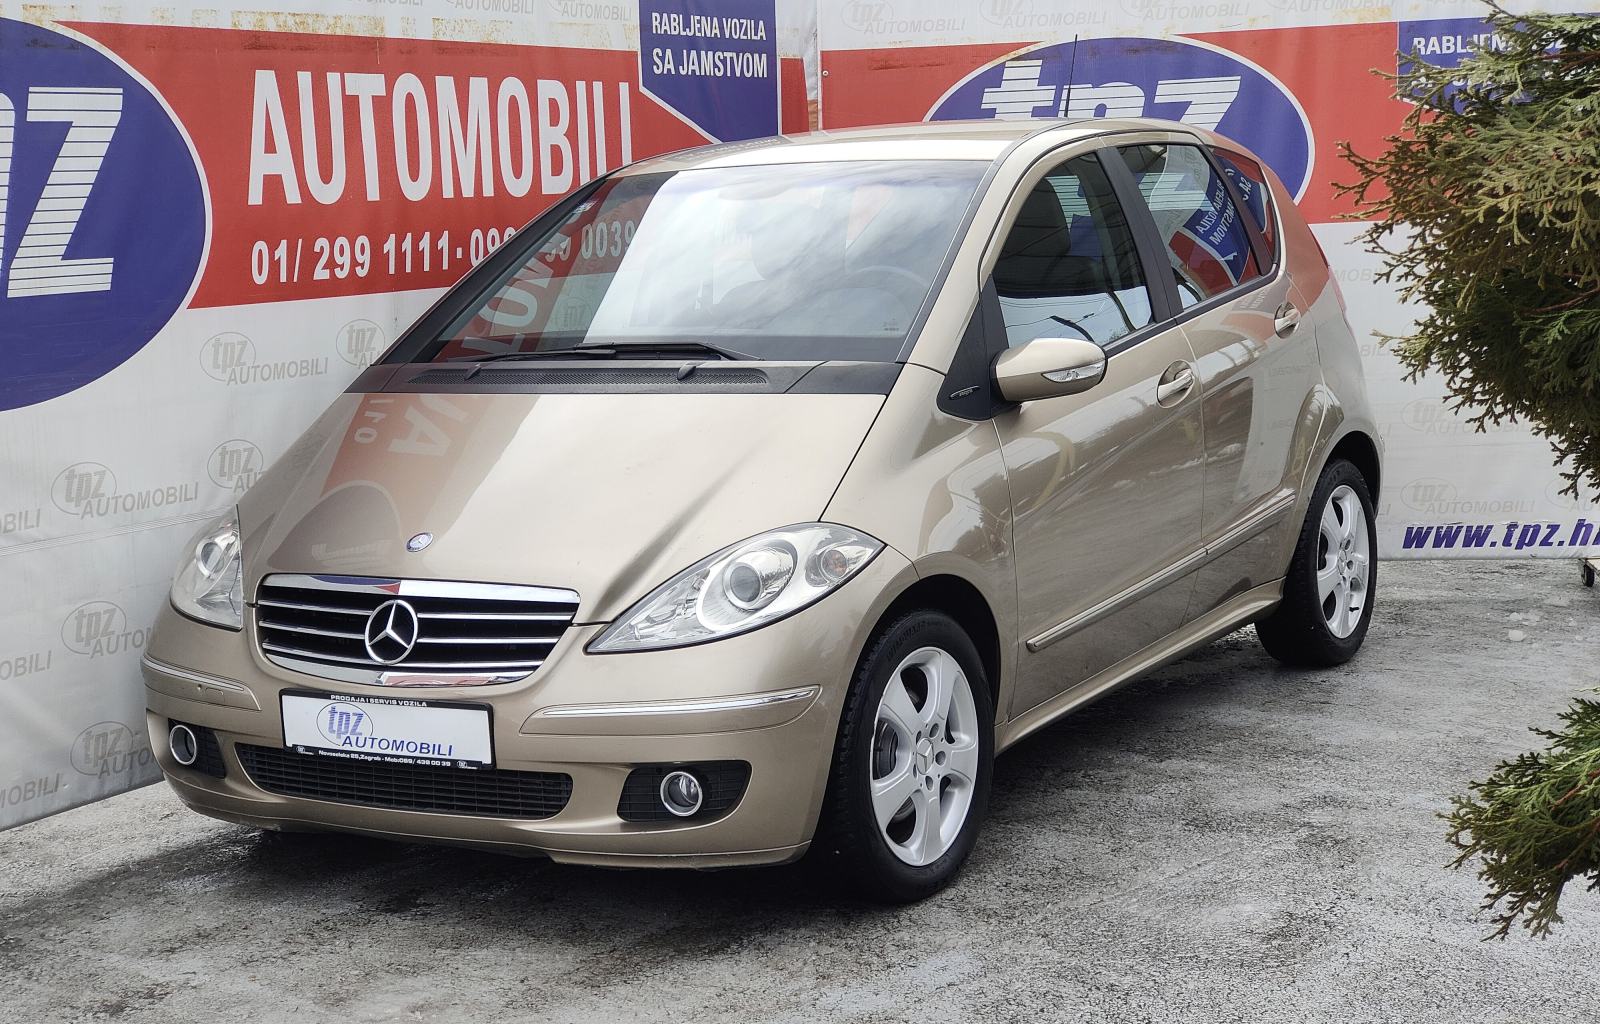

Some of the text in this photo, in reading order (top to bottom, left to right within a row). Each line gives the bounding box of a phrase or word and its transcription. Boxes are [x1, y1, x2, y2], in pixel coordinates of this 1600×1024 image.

[561, 1, 632, 20] AUTOMOBILI
[1002, 11, 1107, 29] AUTOMOBILI
[1142, 2, 1250, 22] AUTOMOBILI
[651, 12, 767, 41] RABLJENA VOZILA
[864, 18, 966, 35] AUTOMOBILI
[652, 47, 768, 78] SA JAMSTVOM
[250, 238, 303, 285] 01/
[312, 235, 372, 281] 299
[211, 337, 248, 374] tpz
[346, 324, 377, 360] tpz
[226, 357, 329, 387] AUTOMOBILI
[217, 446, 254, 481] tpz
[64, 468, 106, 508] tpz
[80, 482, 198, 520] AUTOMOBILI
[0, 508, 41, 534] BILI
[1424, 499, 1536, 515] AUTOMOBILI
[75, 608, 117, 648] tpz
[330, 694, 366, 703] PRODAJA
[369, 698, 398, 706] SERVIS
[327, 705, 364, 739] tpz
[82, 727, 124, 768] tpz
[341, 735, 453, 757] AUTOMOBILI
